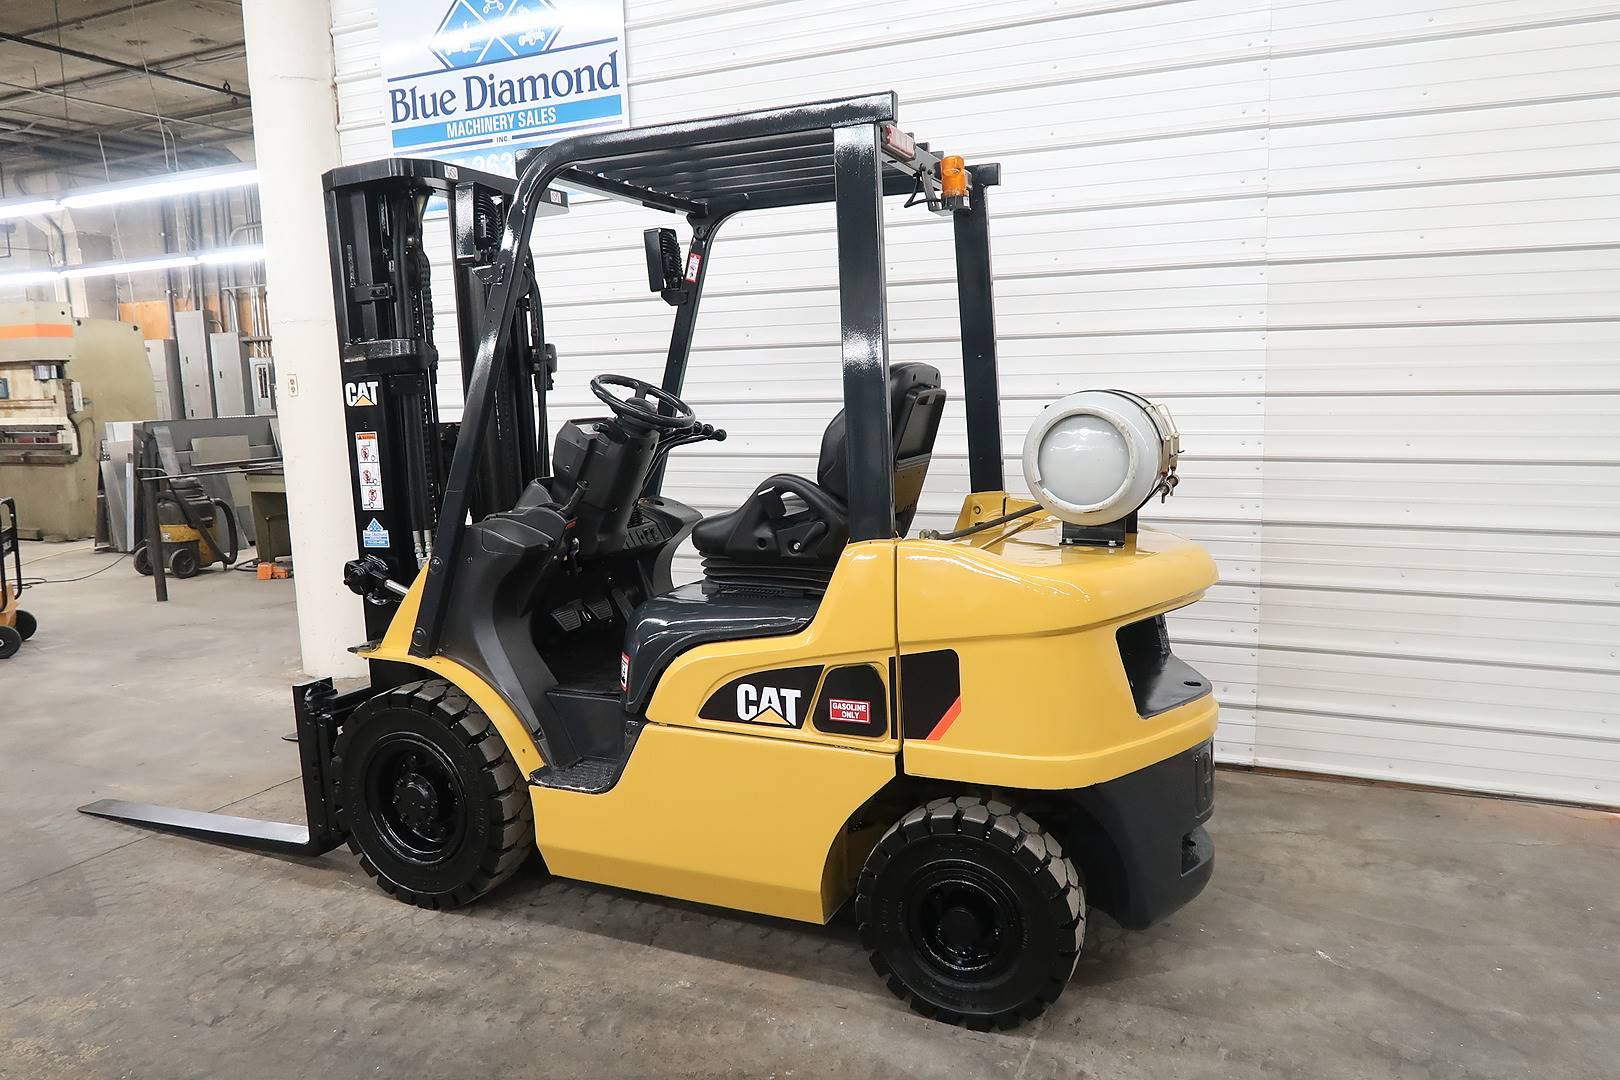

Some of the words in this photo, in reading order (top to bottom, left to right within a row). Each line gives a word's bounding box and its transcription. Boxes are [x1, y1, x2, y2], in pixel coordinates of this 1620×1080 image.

[389, 86, 457, 123] Blue
[464, 50, 620, 111] Diamond
[446, 111, 514, 138] MACHINERY
[518, 107, 557, 127] SALES
[345, 382, 379, 406] CAT
[737, 684, 801, 726] CAT
[832, 702, 866, 711] GASOLINE
[841, 711, 859, 719] ONLY
